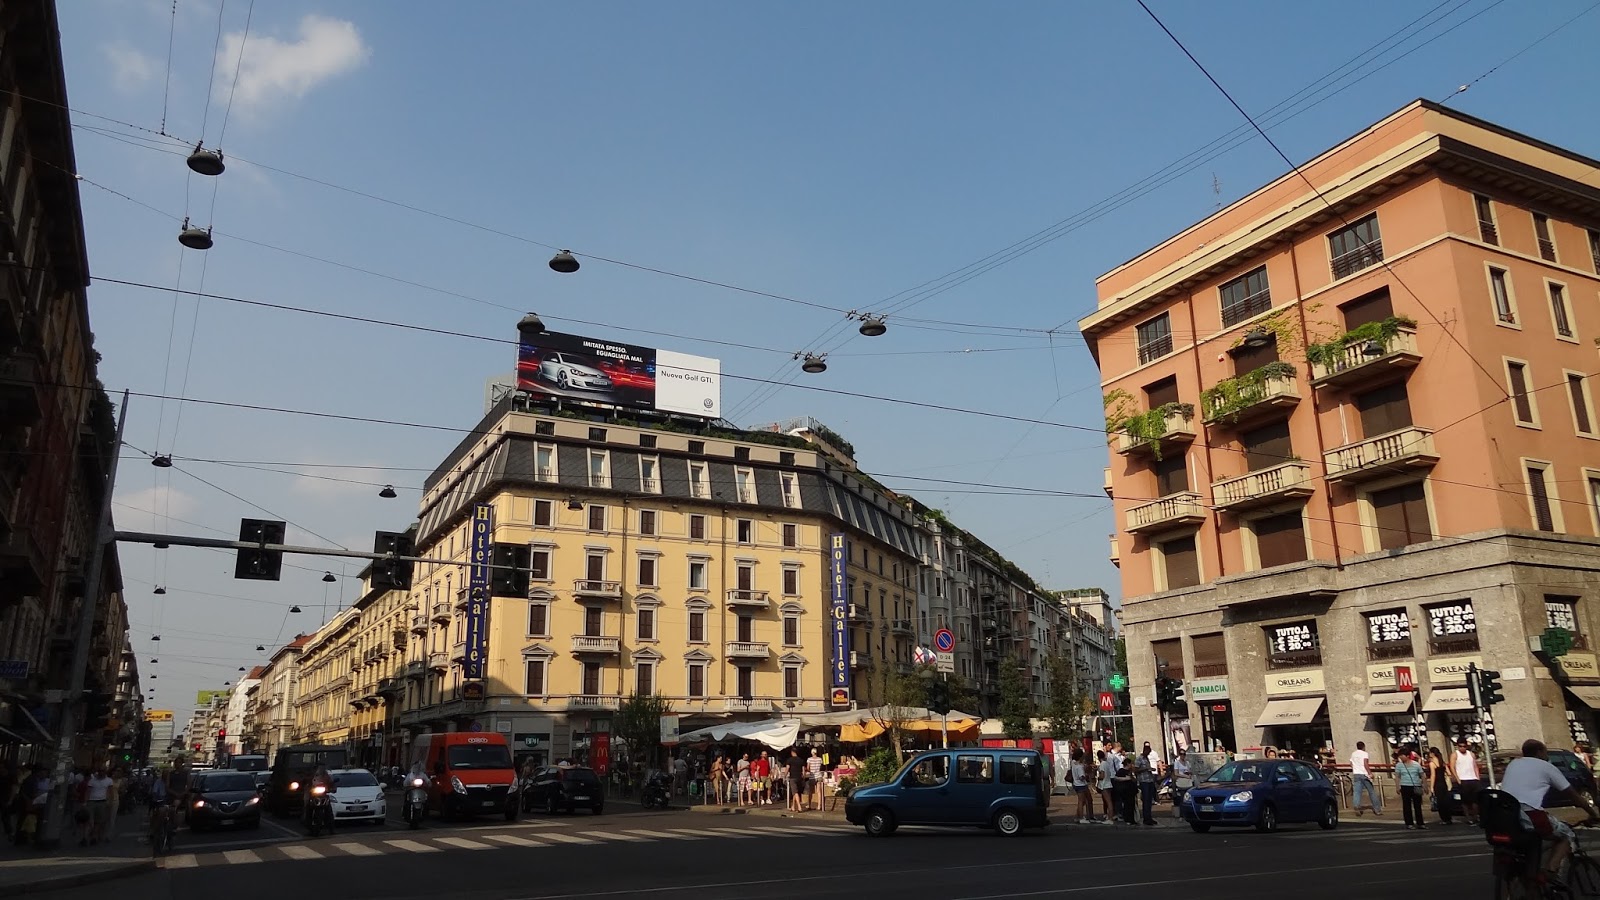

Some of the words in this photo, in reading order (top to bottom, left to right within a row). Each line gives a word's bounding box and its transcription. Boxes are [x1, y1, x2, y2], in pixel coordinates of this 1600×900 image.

[583, 341, 605, 350] IMITATA
[606, 344, 627, 354] SPESSO.
[596, 350, 630, 361] EGUAGLIATA
[661, 370, 683, 380] Nuova
[684, 373, 699, 382] Golf
[700, 376, 714, 384] GTI.
[475, 506, 489, 578] Hotel
[833, 535, 843, 598] Hotel
[1432, 618, 1442, 626] €
[1371, 625, 1379, 633] €
[1433, 626, 1443, 635] €
[1372, 633, 1380, 641] €
[835, 605, 845, 683] Galles
[1434, 664, 1471, 674] ORLEAN
[1564, 661, 1592, 669] ORLEANS
[1372, 670, 1393, 679] ORLE
[1400, 672, 1412, 687] M
[1277, 677, 1311, 686] ORLEANS
[1192, 684, 1227, 694] FARMACIA
[1101, 696, 1112, 707] M
